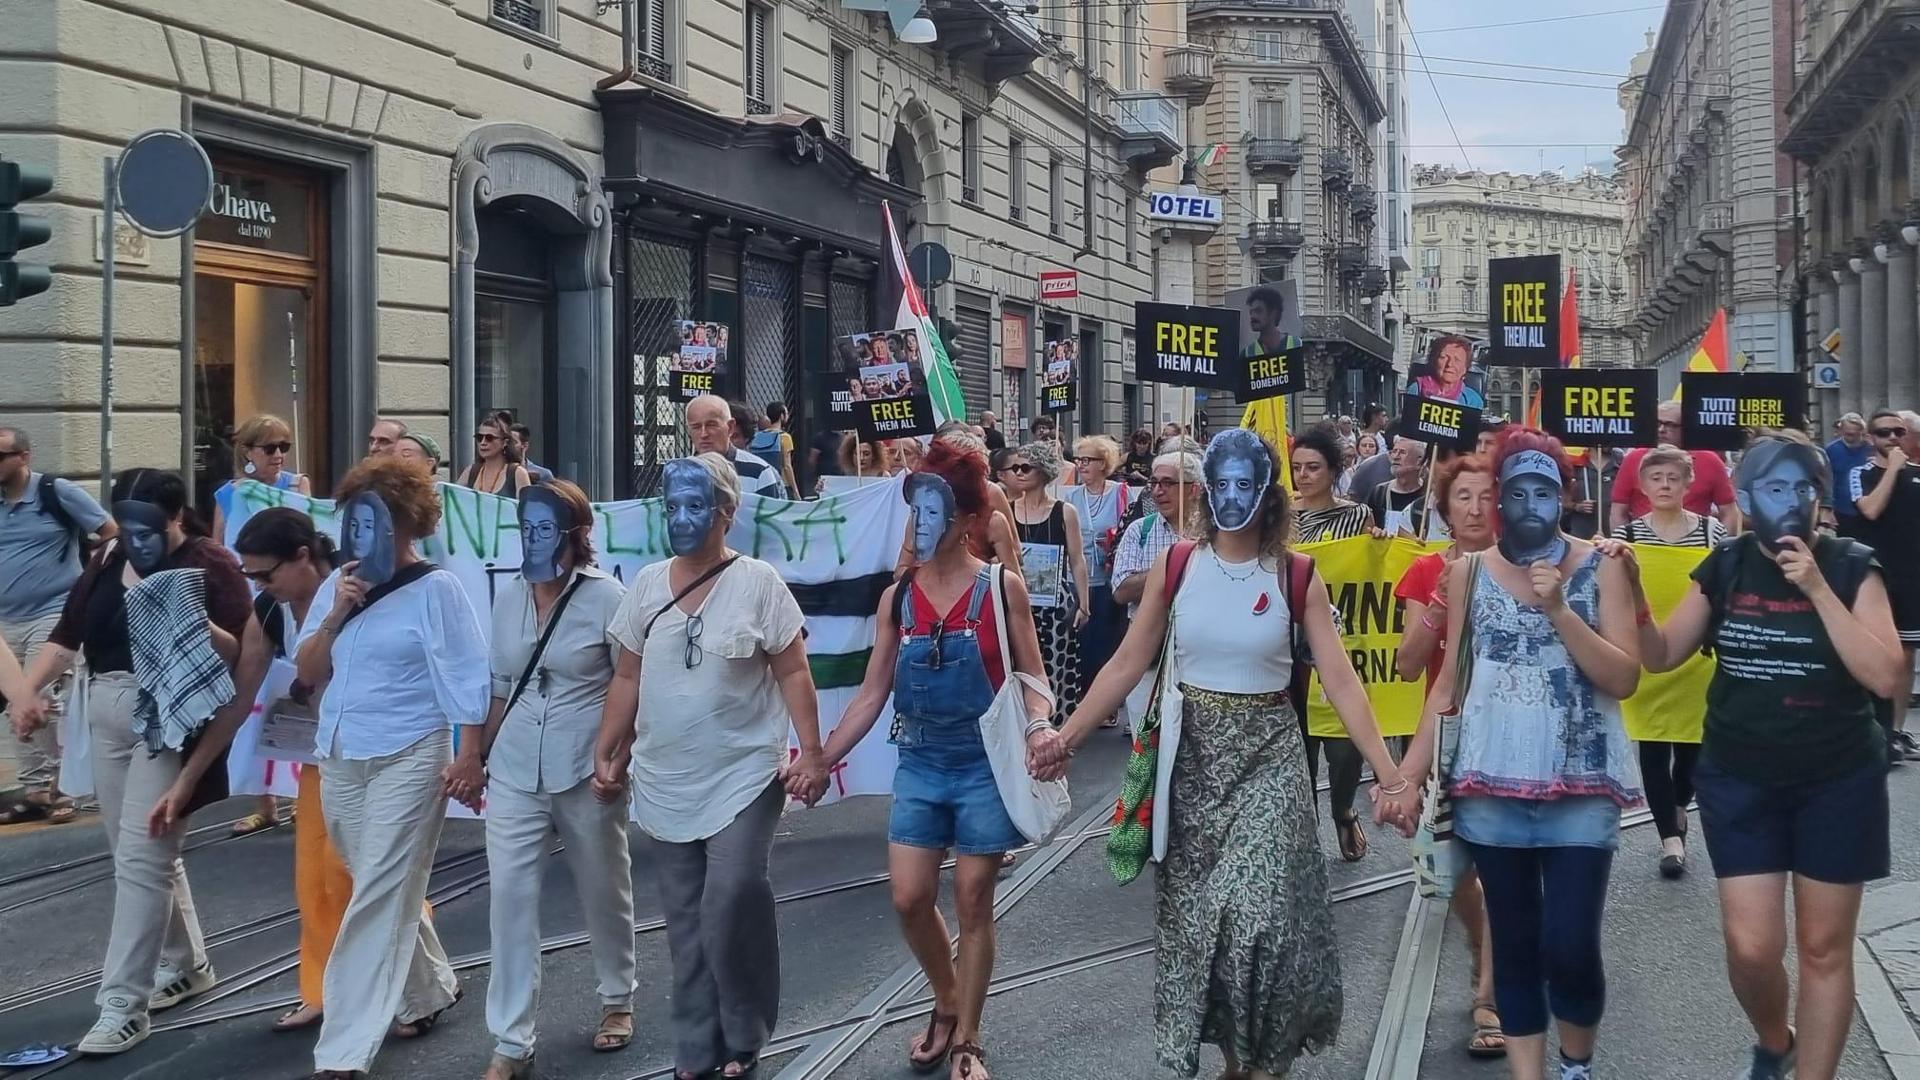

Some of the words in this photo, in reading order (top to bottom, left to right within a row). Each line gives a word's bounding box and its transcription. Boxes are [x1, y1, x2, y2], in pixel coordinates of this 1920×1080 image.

[210, 183, 276, 223] Chave.
[238, 223, 251, 236] dal
[1503, 283, 1546, 323] FREE
[1156, 322, 1219, 357] FREE
[1504, 326, 1526, 348] THEM
[1528, 326, 1546, 348] ALL
[1156, 353, 1191, 372] THEM
[1195, 358, 1217, 375] ALL
[1250, 355, 1289, 380] FREE
[681, 374, 713, 390] FREE
[1251, 374, 1289, 390] DOMENICO
[831, 391, 850, 401] TUTT
[1049, 386, 1069, 400] FREE
[831, 401, 853, 412] TUTTE
[871, 400, 914, 421] FREE
[1564, 387, 1634, 417] FREE
[1701, 397, 1736, 411] TUTTI
[1740, 399, 1782, 412] LIBERI
[1420, 402, 1463, 429] FREE
[1698, 412, 1736, 425] TUTTE
[1739, 413, 1785, 427] LIBERE
[874, 420, 899, 432] THEM
[901, 418, 917, 429] ALL
[1418, 421, 1459, 438] LEONARDA
[1565, 417, 1604, 433] THEM
[1608, 418, 1634, 434] ALL
